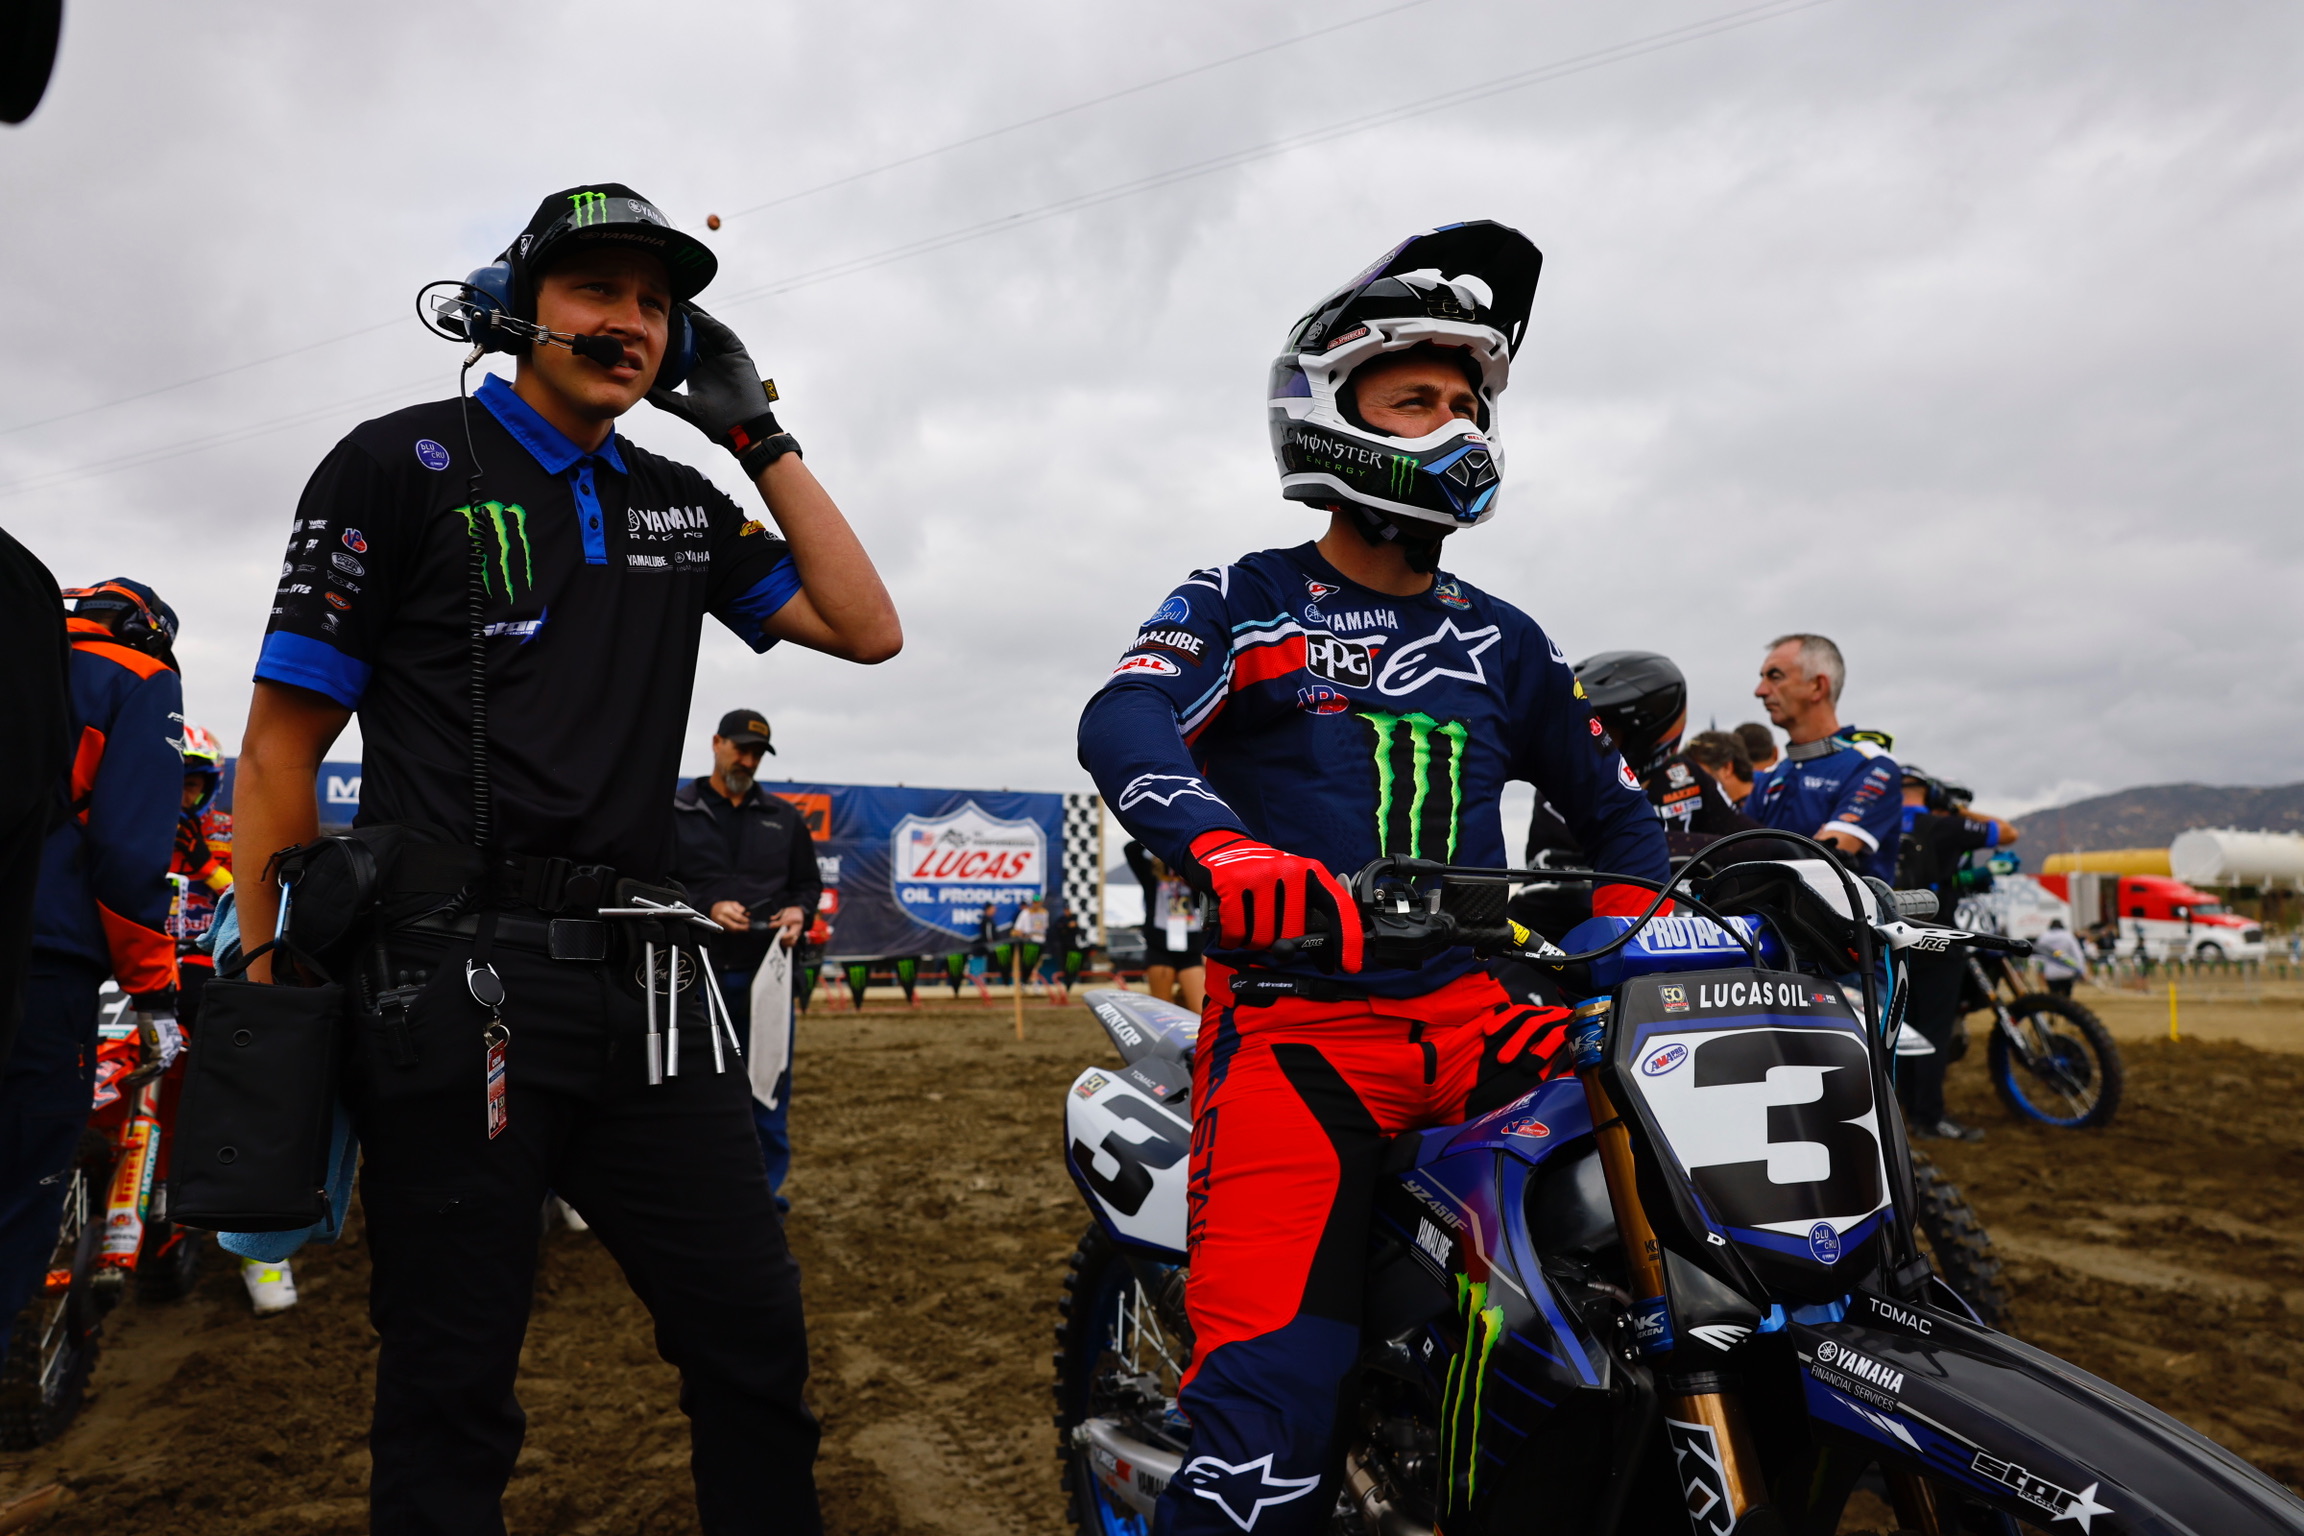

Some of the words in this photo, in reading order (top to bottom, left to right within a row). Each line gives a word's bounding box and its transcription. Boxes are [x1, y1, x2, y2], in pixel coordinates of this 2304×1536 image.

[601, 232, 667, 246] YAMAHA
[1306, 455, 1366, 477] ENERGY
[627, 554, 668, 567] YAMALUBE
[1327, 609, 1399, 632] YAMAHA
[1309, 638, 1368, 679] PPG
[912, 850, 1032, 879] LUCAS
[902, 888, 935, 903] OIL
[1302, 938, 1324, 949] ARC
[1700, 981, 1774, 1009] LUCAS
[1095, 1002, 1142, 1047] DUNLOP
[1131, 1070, 1157, 1088] TOMAC
[1690, 1030, 1884, 1227] 3
[1402, 1180, 1468, 1231] YZ450F
[1416, 1216, 1454, 1269] YAMALUBE
[1870, 1297, 1932, 1335] TOMAC
[1836, 1347, 1905, 1394] YAMAHA
[1811, 1365, 1853, 1393] FINANCIAL
[1854, 1386, 1895, 1412] SERVICES
[2020, 1490, 2067, 1516] RACING
